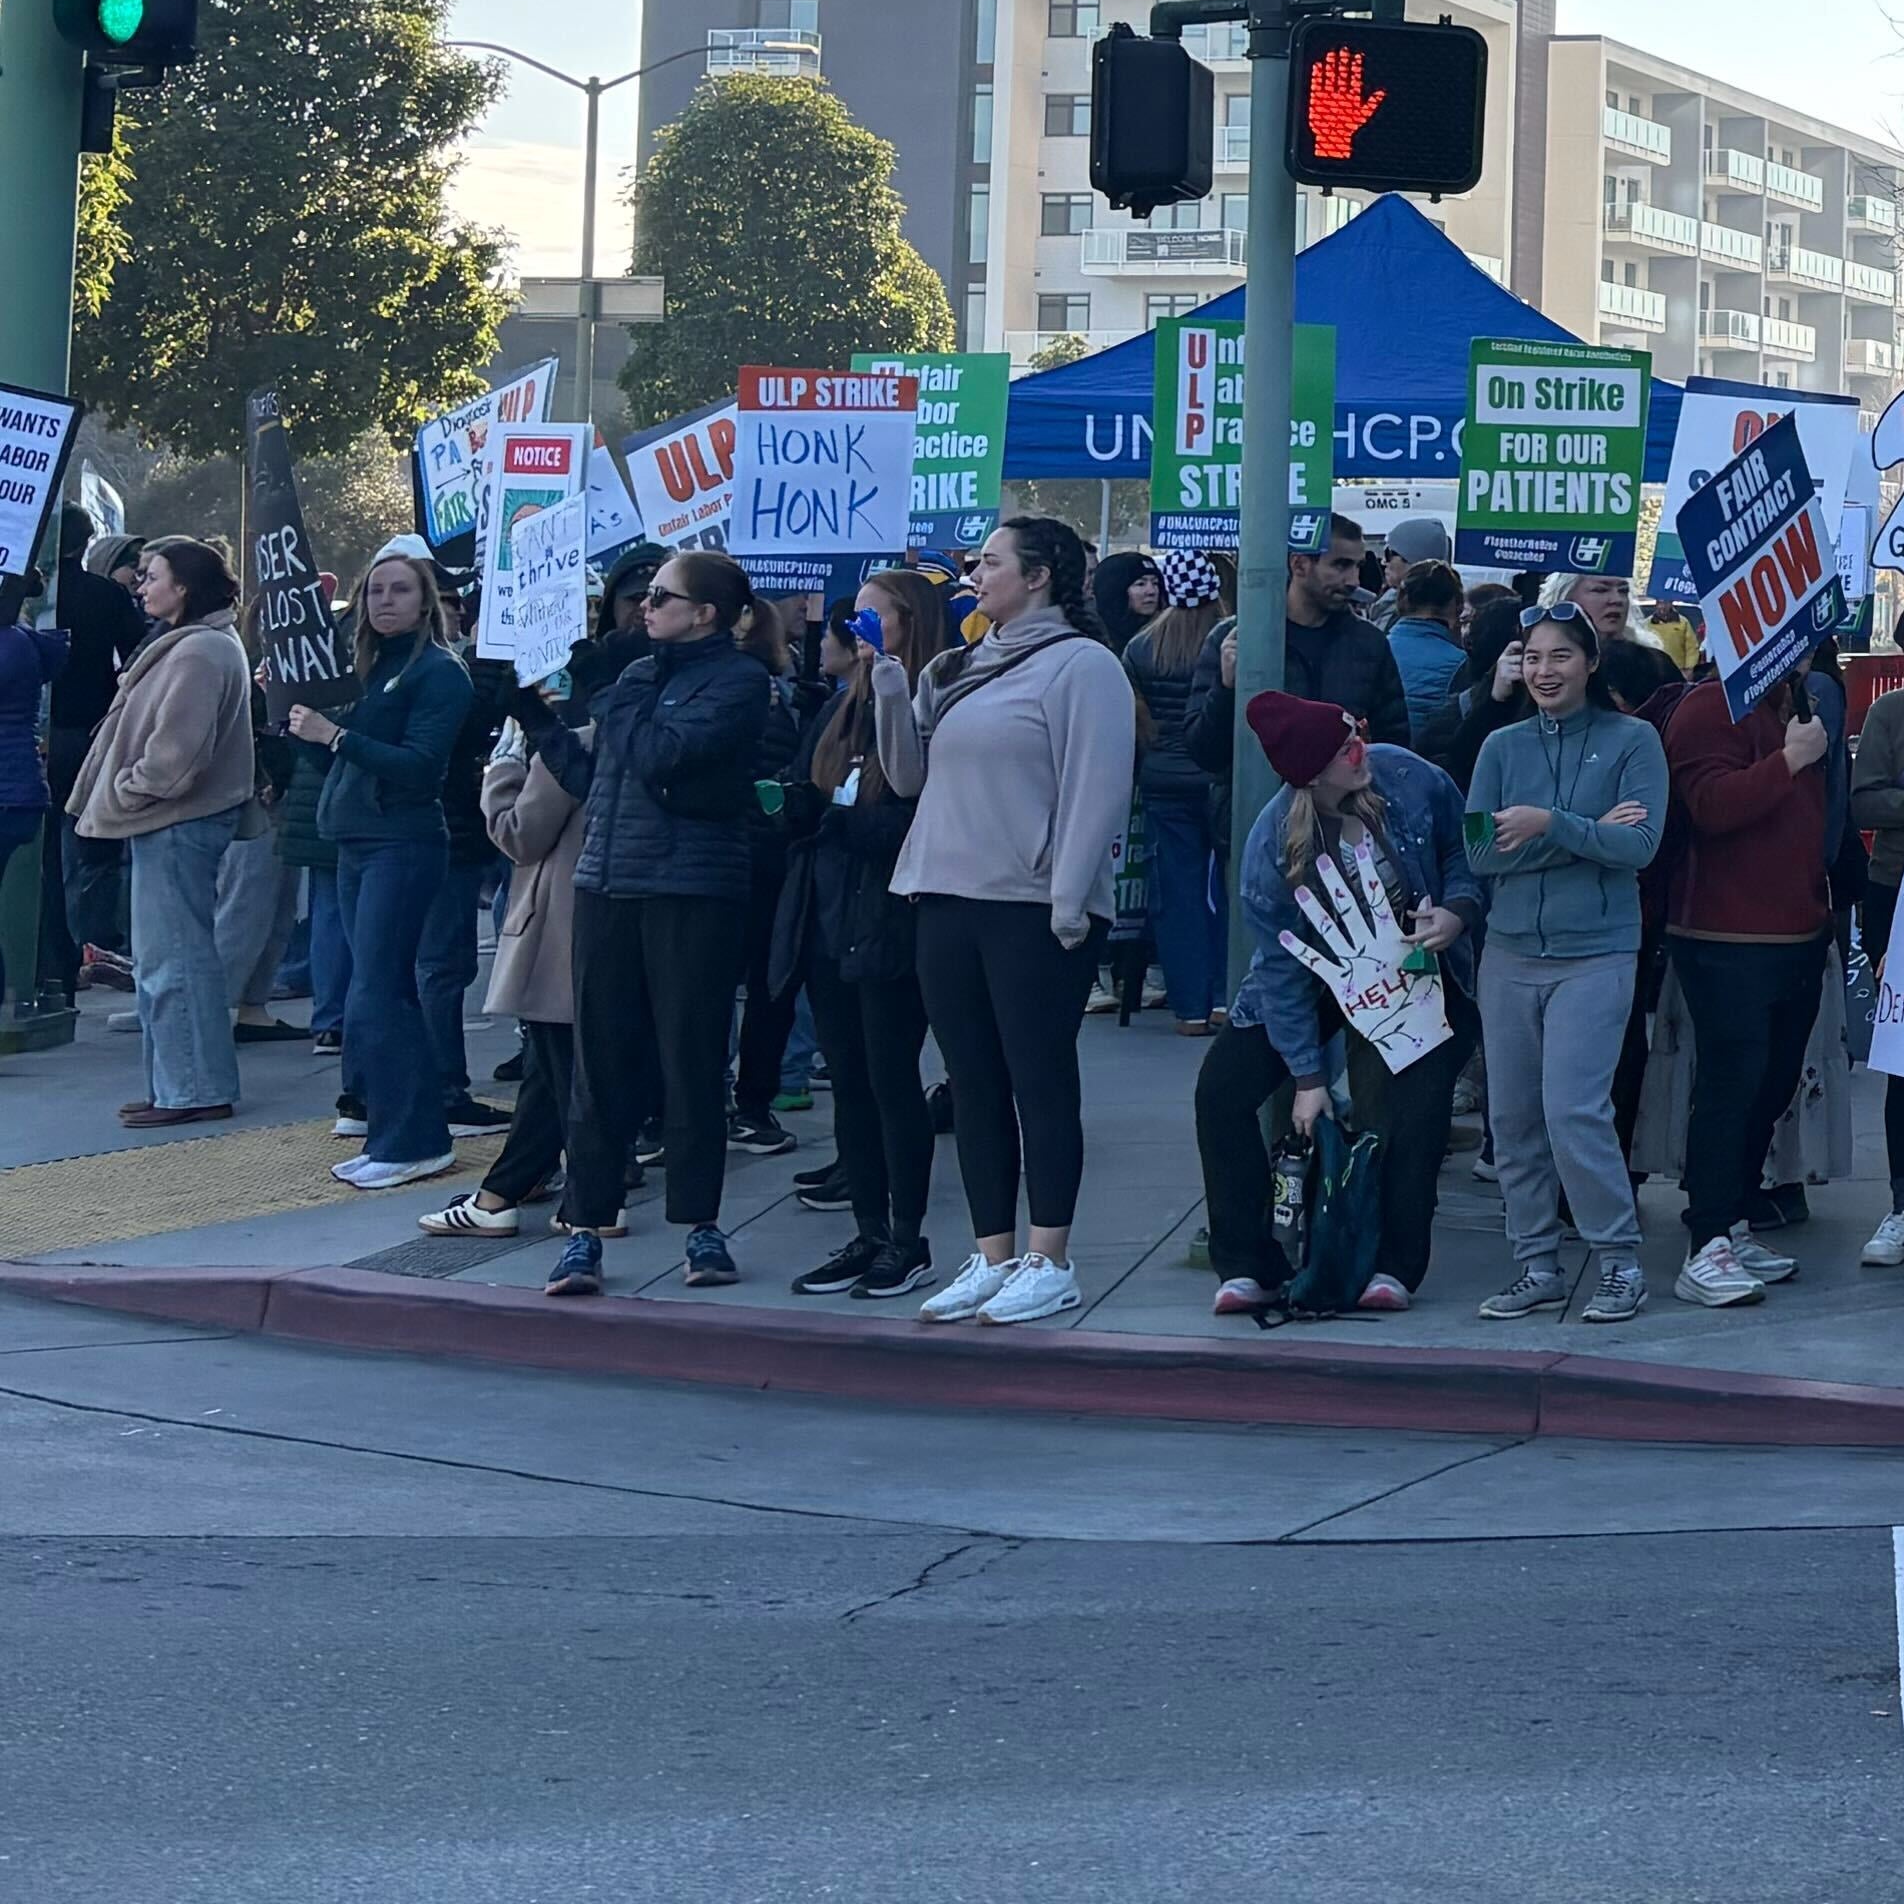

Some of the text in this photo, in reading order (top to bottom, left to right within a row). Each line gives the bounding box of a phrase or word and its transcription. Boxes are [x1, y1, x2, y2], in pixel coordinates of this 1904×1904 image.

[1188, 332, 1244, 368] Unf
[759, 377, 899, 408] ULP STRIKE
[917, 398, 960, 424] bor
[1488, 375, 1625, 412] On Strike
[0, 444, 49, 472] ABOR
[513, 446, 562, 468] NOTICE
[655, 418, 736, 502] ULP
[757, 422, 875, 474] HONK
[914, 431, 988, 459] actice
[1500, 432, 1607, 465] FOR OUR
[909, 471, 978, 511] RIKE
[1179, 462, 1307, 508] STRE
[1467, 469, 1632, 515] PATIENTS
[1716, 448, 1770, 521] FAIR
[751, 478, 884, 542] HONK
[1707, 470, 1796, 572] CONTRACT
[518, 549, 580, 589] thrive
[1719, 509, 1822, 660] NOW
[267, 581, 326, 631] LOST
[274, 628, 353, 684] WAY.
